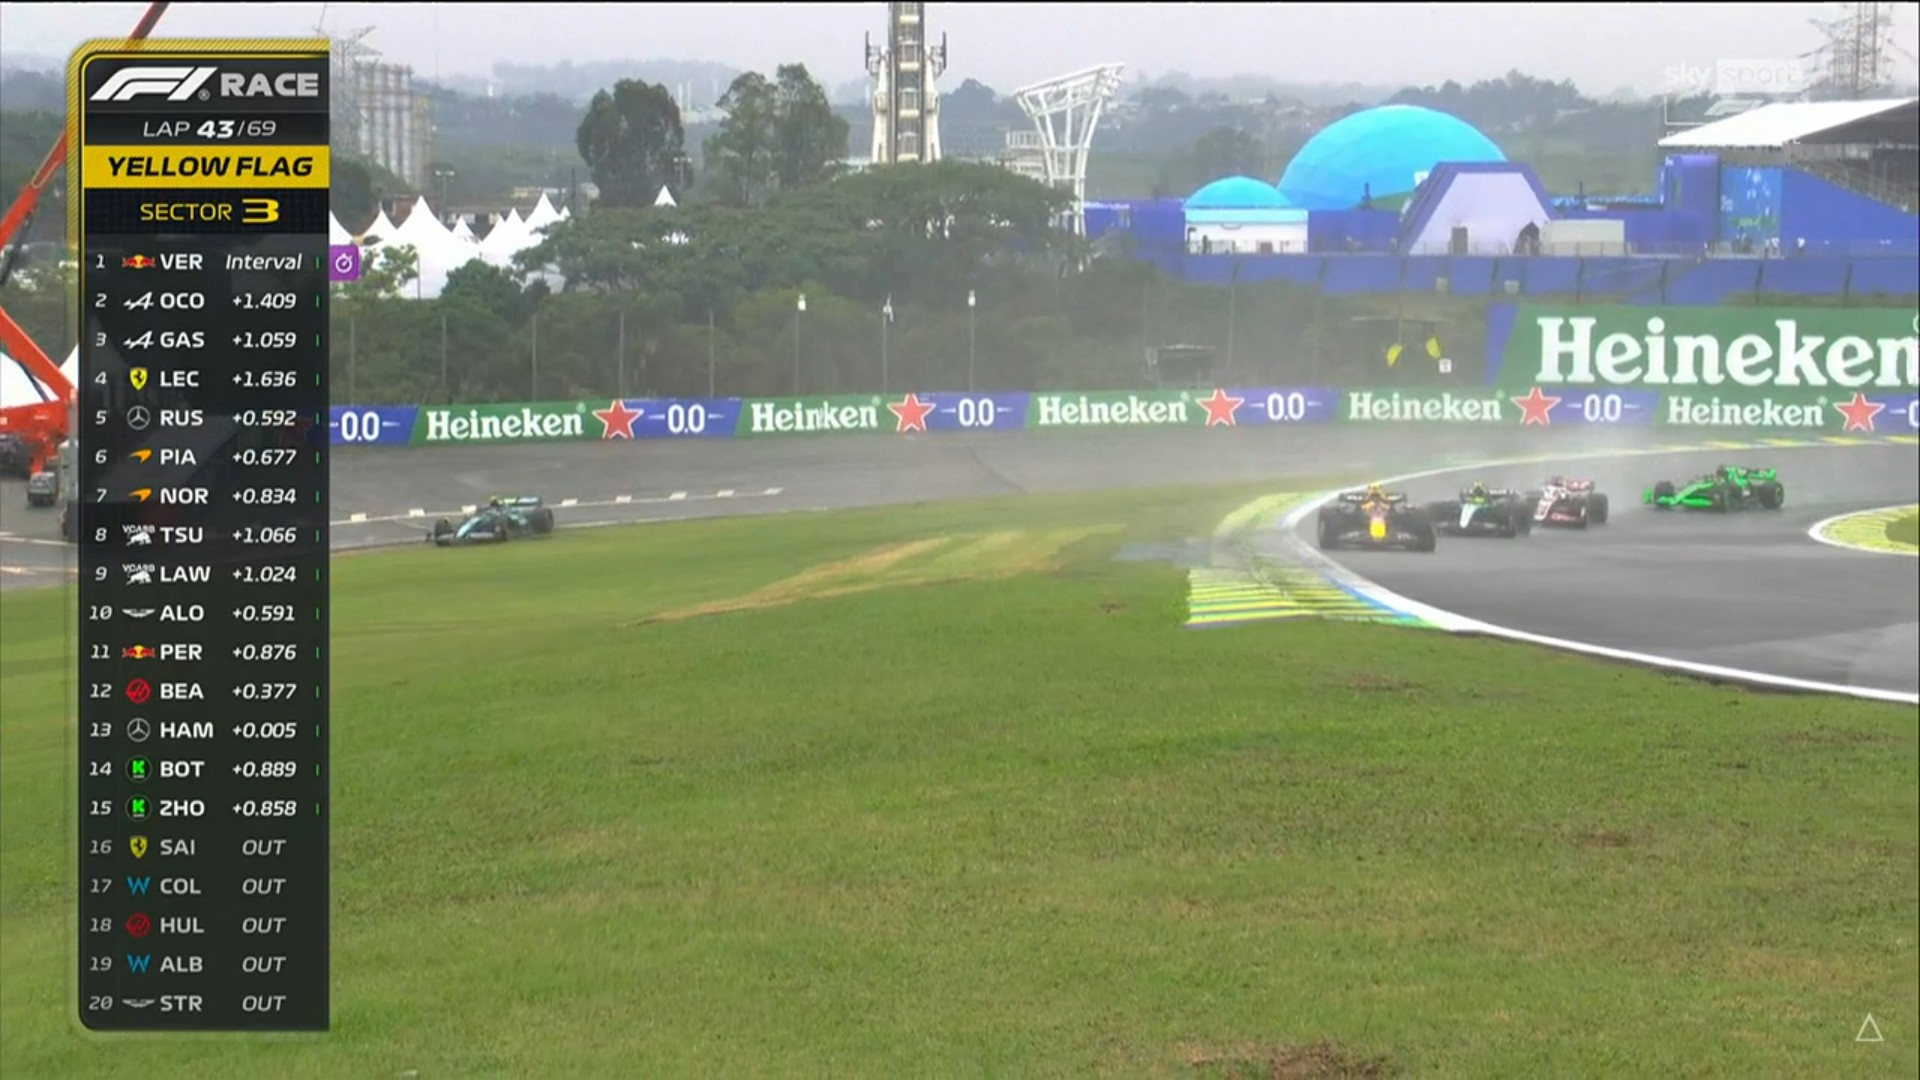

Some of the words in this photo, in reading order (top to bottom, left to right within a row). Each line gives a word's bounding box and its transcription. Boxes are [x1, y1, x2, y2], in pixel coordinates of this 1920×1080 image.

[1536, 317, 1919, 386] Heineken
[668, 404, 705, 434] 0.0
[958, 398, 994, 427] 0.0
[1038, 396, 1188, 425] Heineken
[1267, 393, 1305, 421] 0.0
[1349, 392, 1502, 420] Heineken
[1584, 394, 1622, 422] 0.0
[1667, 396, 1824, 426] Heineken
[341, 411, 379, 441] 0.0
[426, 409, 583, 440] Heineken
